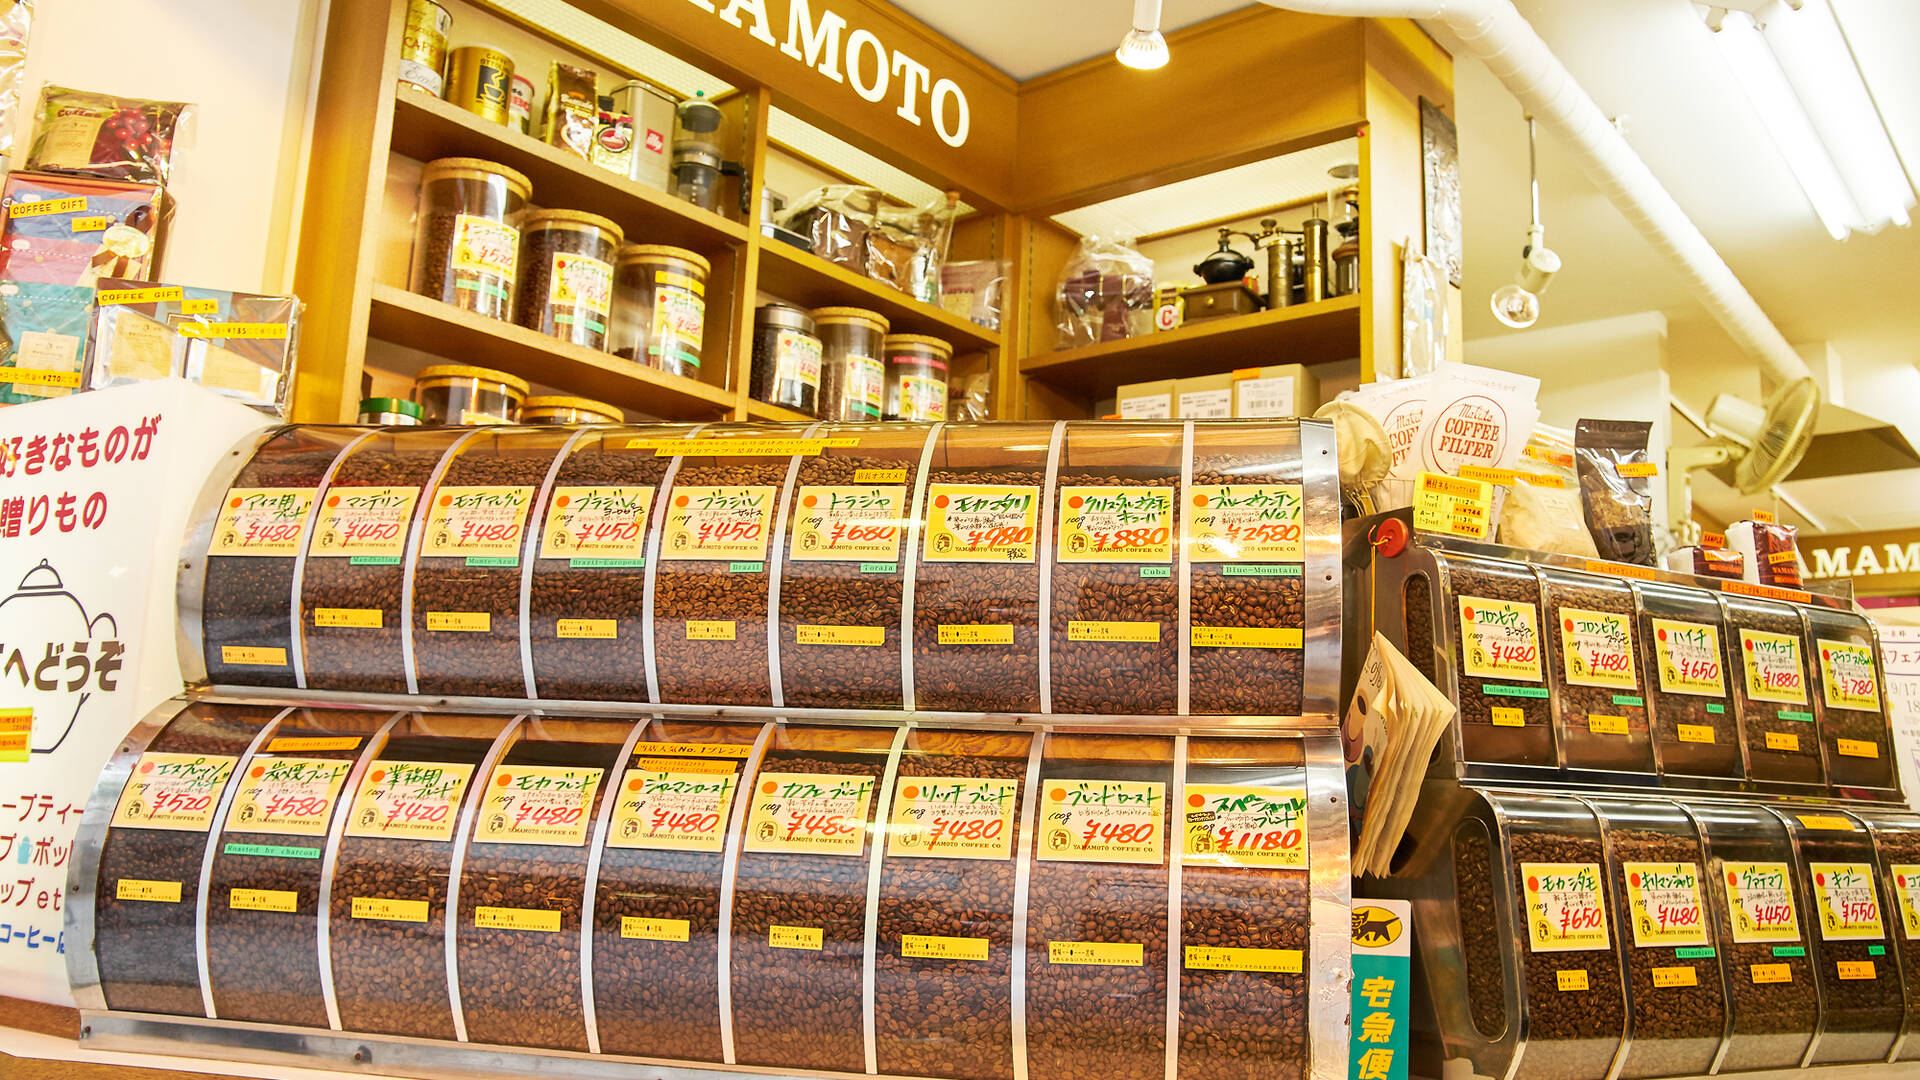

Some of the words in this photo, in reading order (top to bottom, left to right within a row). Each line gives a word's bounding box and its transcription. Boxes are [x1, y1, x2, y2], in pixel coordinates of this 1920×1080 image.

[688, 0, 970, 148] AMOTO
[13, 203, 52, 215] COFFEE
[60, 200, 84, 210] GIFT
[101, 292, 144, 302] COFFEE
[154, 290, 180, 299] GIFT
[1388, 425, 1419, 450] COF
[1444, 416, 1500, 443] COFFEE
[1437, 434, 1495, 460] FILTER
[346, 489, 410, 511] マンデリン
[574, 488, 640, 513] ブラジル
[697, 488, 765, 510] ブラジル
[829, 489, 891, 511] トラジャ
[954, 492, 1032, 513] モカマタリ
[0, 491, 108, 538] 贈りもの
[1116, 509, 1167, 526] キューバ
[1143, 568, 1167, 576] Cuba
[1225, 566, 1299, 574] Blue-Mountain
[1476, 604, 1520, 629] コロンビア
[1577, 616, 1620, 637] コロンビア
[1674, 628, 1707, 651] ハイチ
[1755, 639, 1796, 660] ハワイコナ
[0, 640, 126, 693] へどうぞ
[516, 774, 552, 791] モカ
[782, 782, 826, 799] カフェ
[922, 784, 967, 806] リッチ
[1254, 809, 1304, 829] ブレンド
[1357, 975, 1396, 1080] 宅急便
